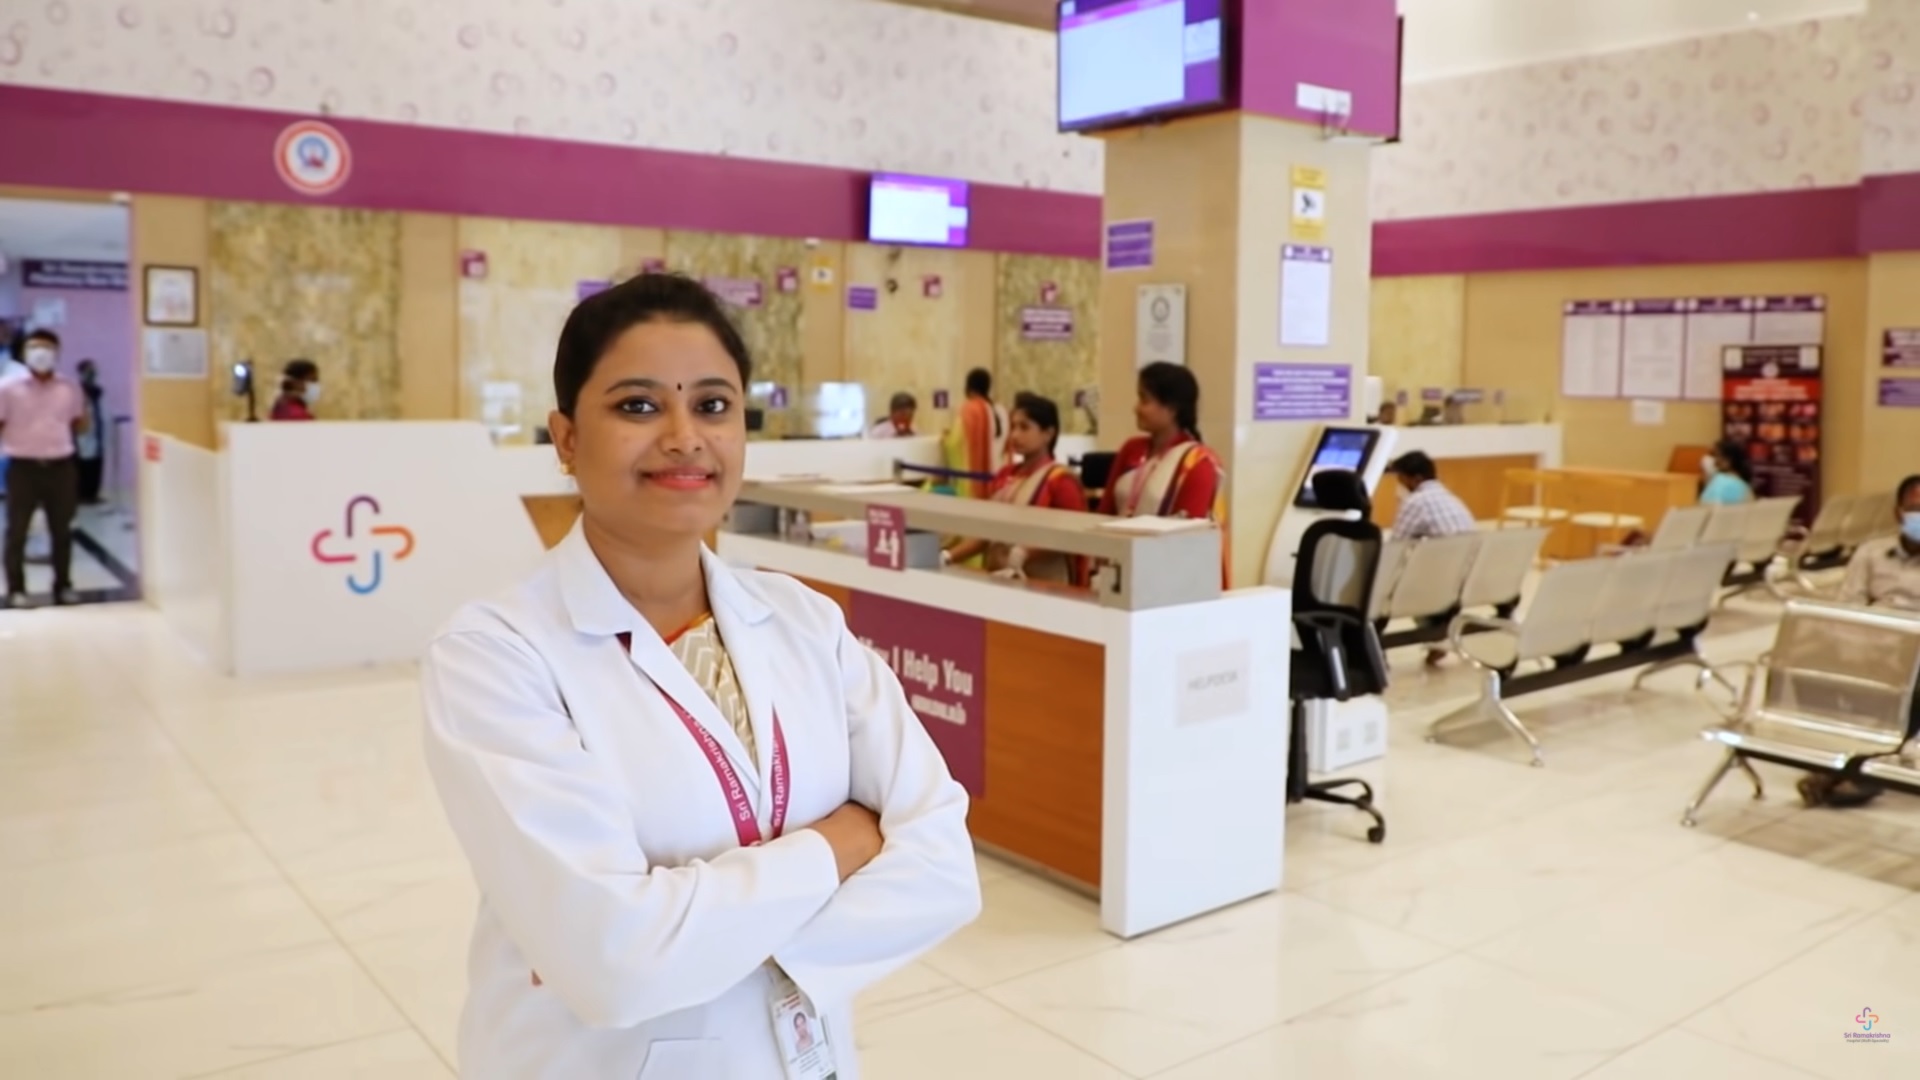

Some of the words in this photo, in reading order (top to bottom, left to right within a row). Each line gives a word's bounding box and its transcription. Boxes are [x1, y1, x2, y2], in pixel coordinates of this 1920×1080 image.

[892, 645, 899, 676] I
[903, 648, 938, 692] Help
[942, 659, 973, 697] You
[736, 800, 751, 821] Sri
